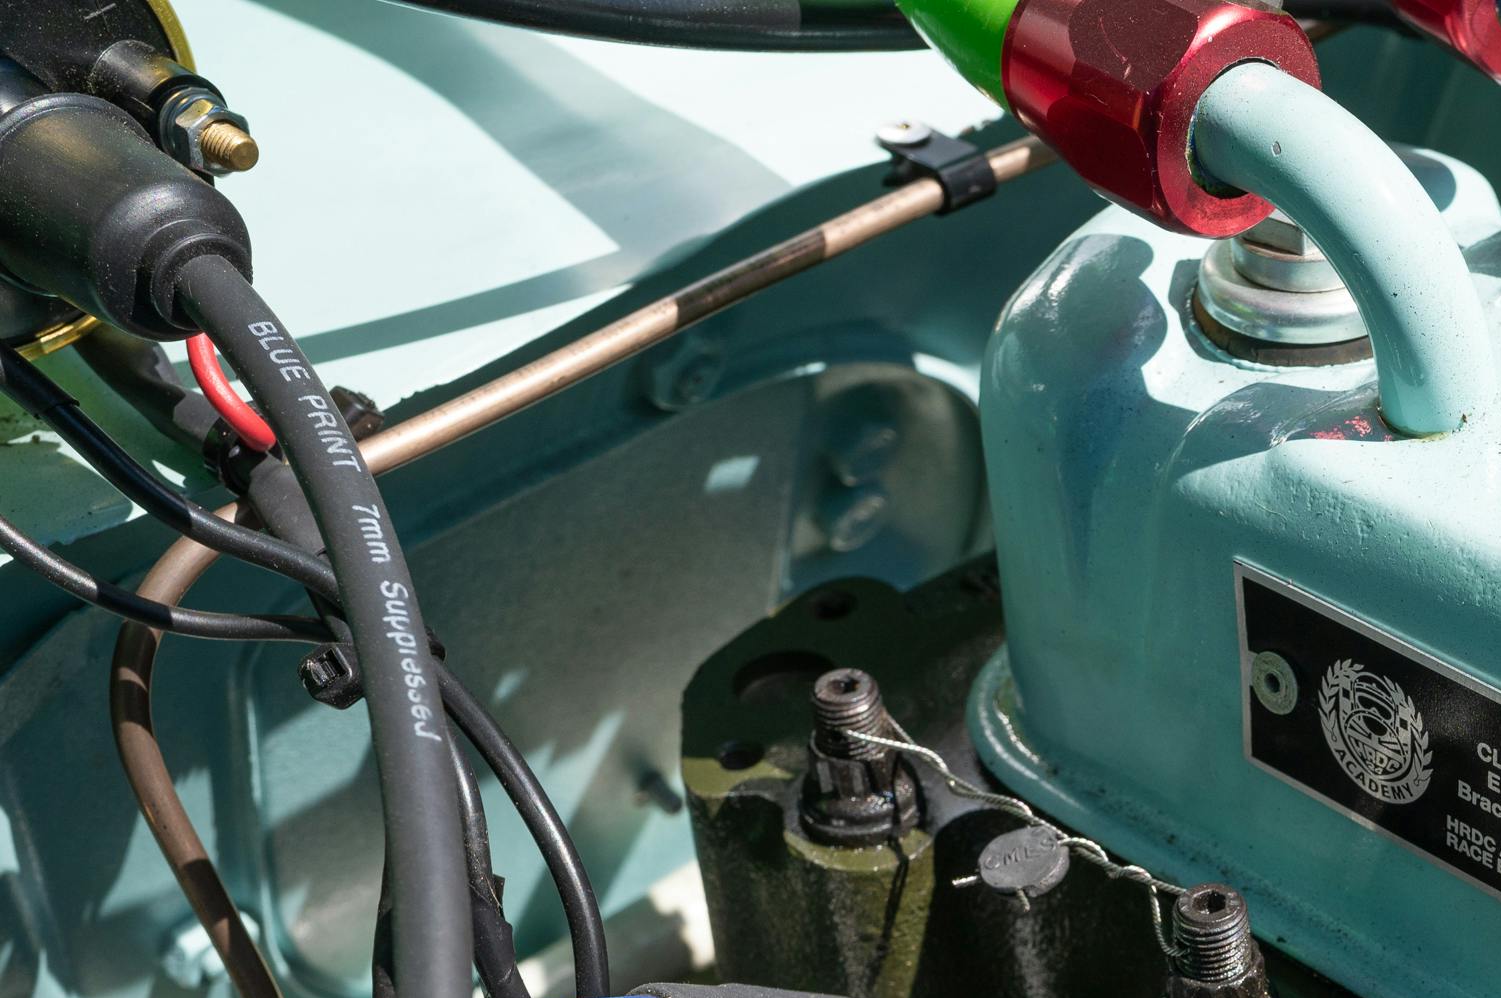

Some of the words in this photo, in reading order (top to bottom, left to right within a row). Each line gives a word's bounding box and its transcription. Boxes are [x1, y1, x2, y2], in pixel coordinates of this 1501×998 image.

[248, 319, 311, 383] BLUE
[298, 394, 361, 473] PRINT
[351, 503, 391, 565] 7mm
[1335, 750, 1413, 800] ACADEMY
[1446, 814, 1496, 852] HRDC
[1446, 831, 1493, 870] RACE
